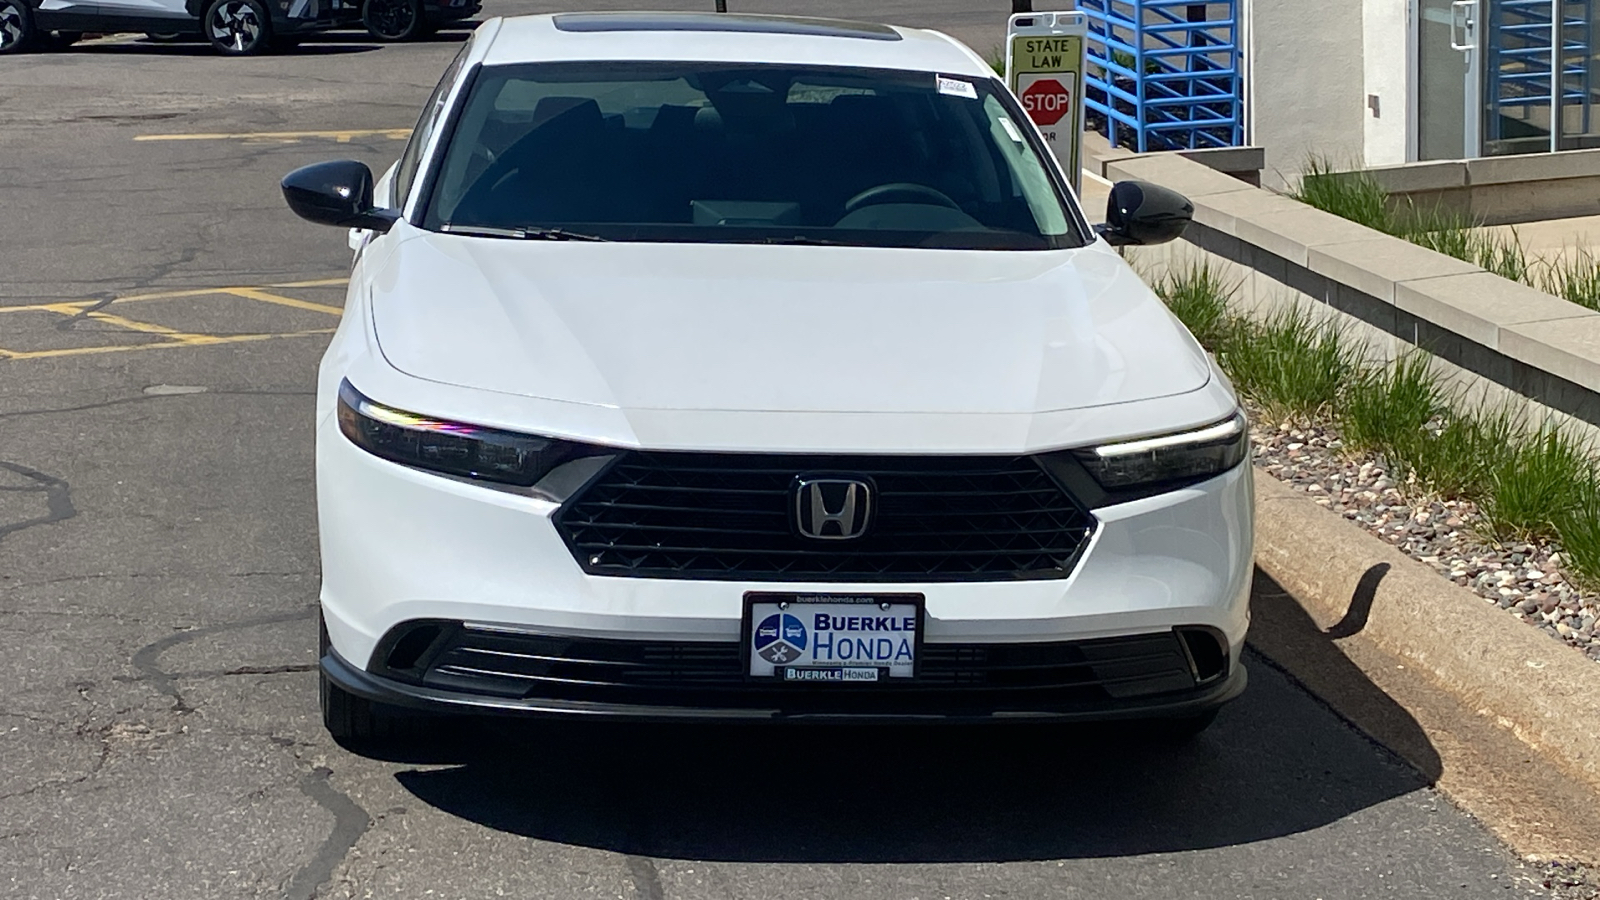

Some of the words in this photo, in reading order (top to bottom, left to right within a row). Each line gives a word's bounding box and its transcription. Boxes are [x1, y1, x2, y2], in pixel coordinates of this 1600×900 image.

[1026, 39, 1069, 53] STATE
[1031, 56, 1063, 68] LAW
[1024, 94, 1069, 111] STOP
[1042, 132, 1056, 141] OR
[796, 595, 874, 604] buerklehonda.com
[814, 613, 916, 631] BUERKLE
[812, 632, 913, 660] HONDA
[787, 668, 842, 680] BUERKLE
[844, 669, 876, 679] HONDA
